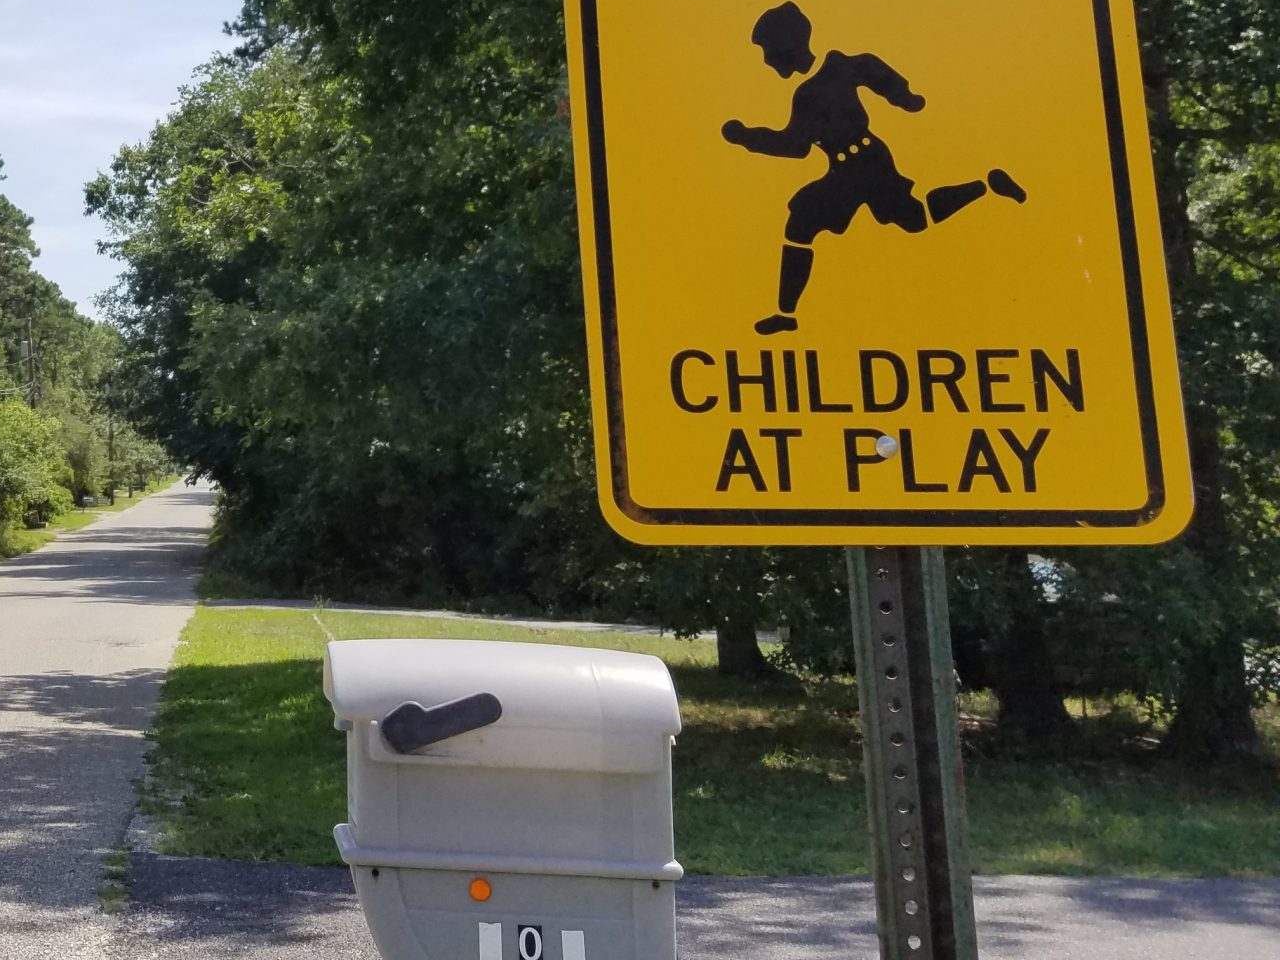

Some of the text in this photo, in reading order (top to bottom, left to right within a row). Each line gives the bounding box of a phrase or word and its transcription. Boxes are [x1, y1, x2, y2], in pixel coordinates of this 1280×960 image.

[670, 348, 1085, 414] CHILDREN
[715, 428, 1051, 494] AT PLAY
